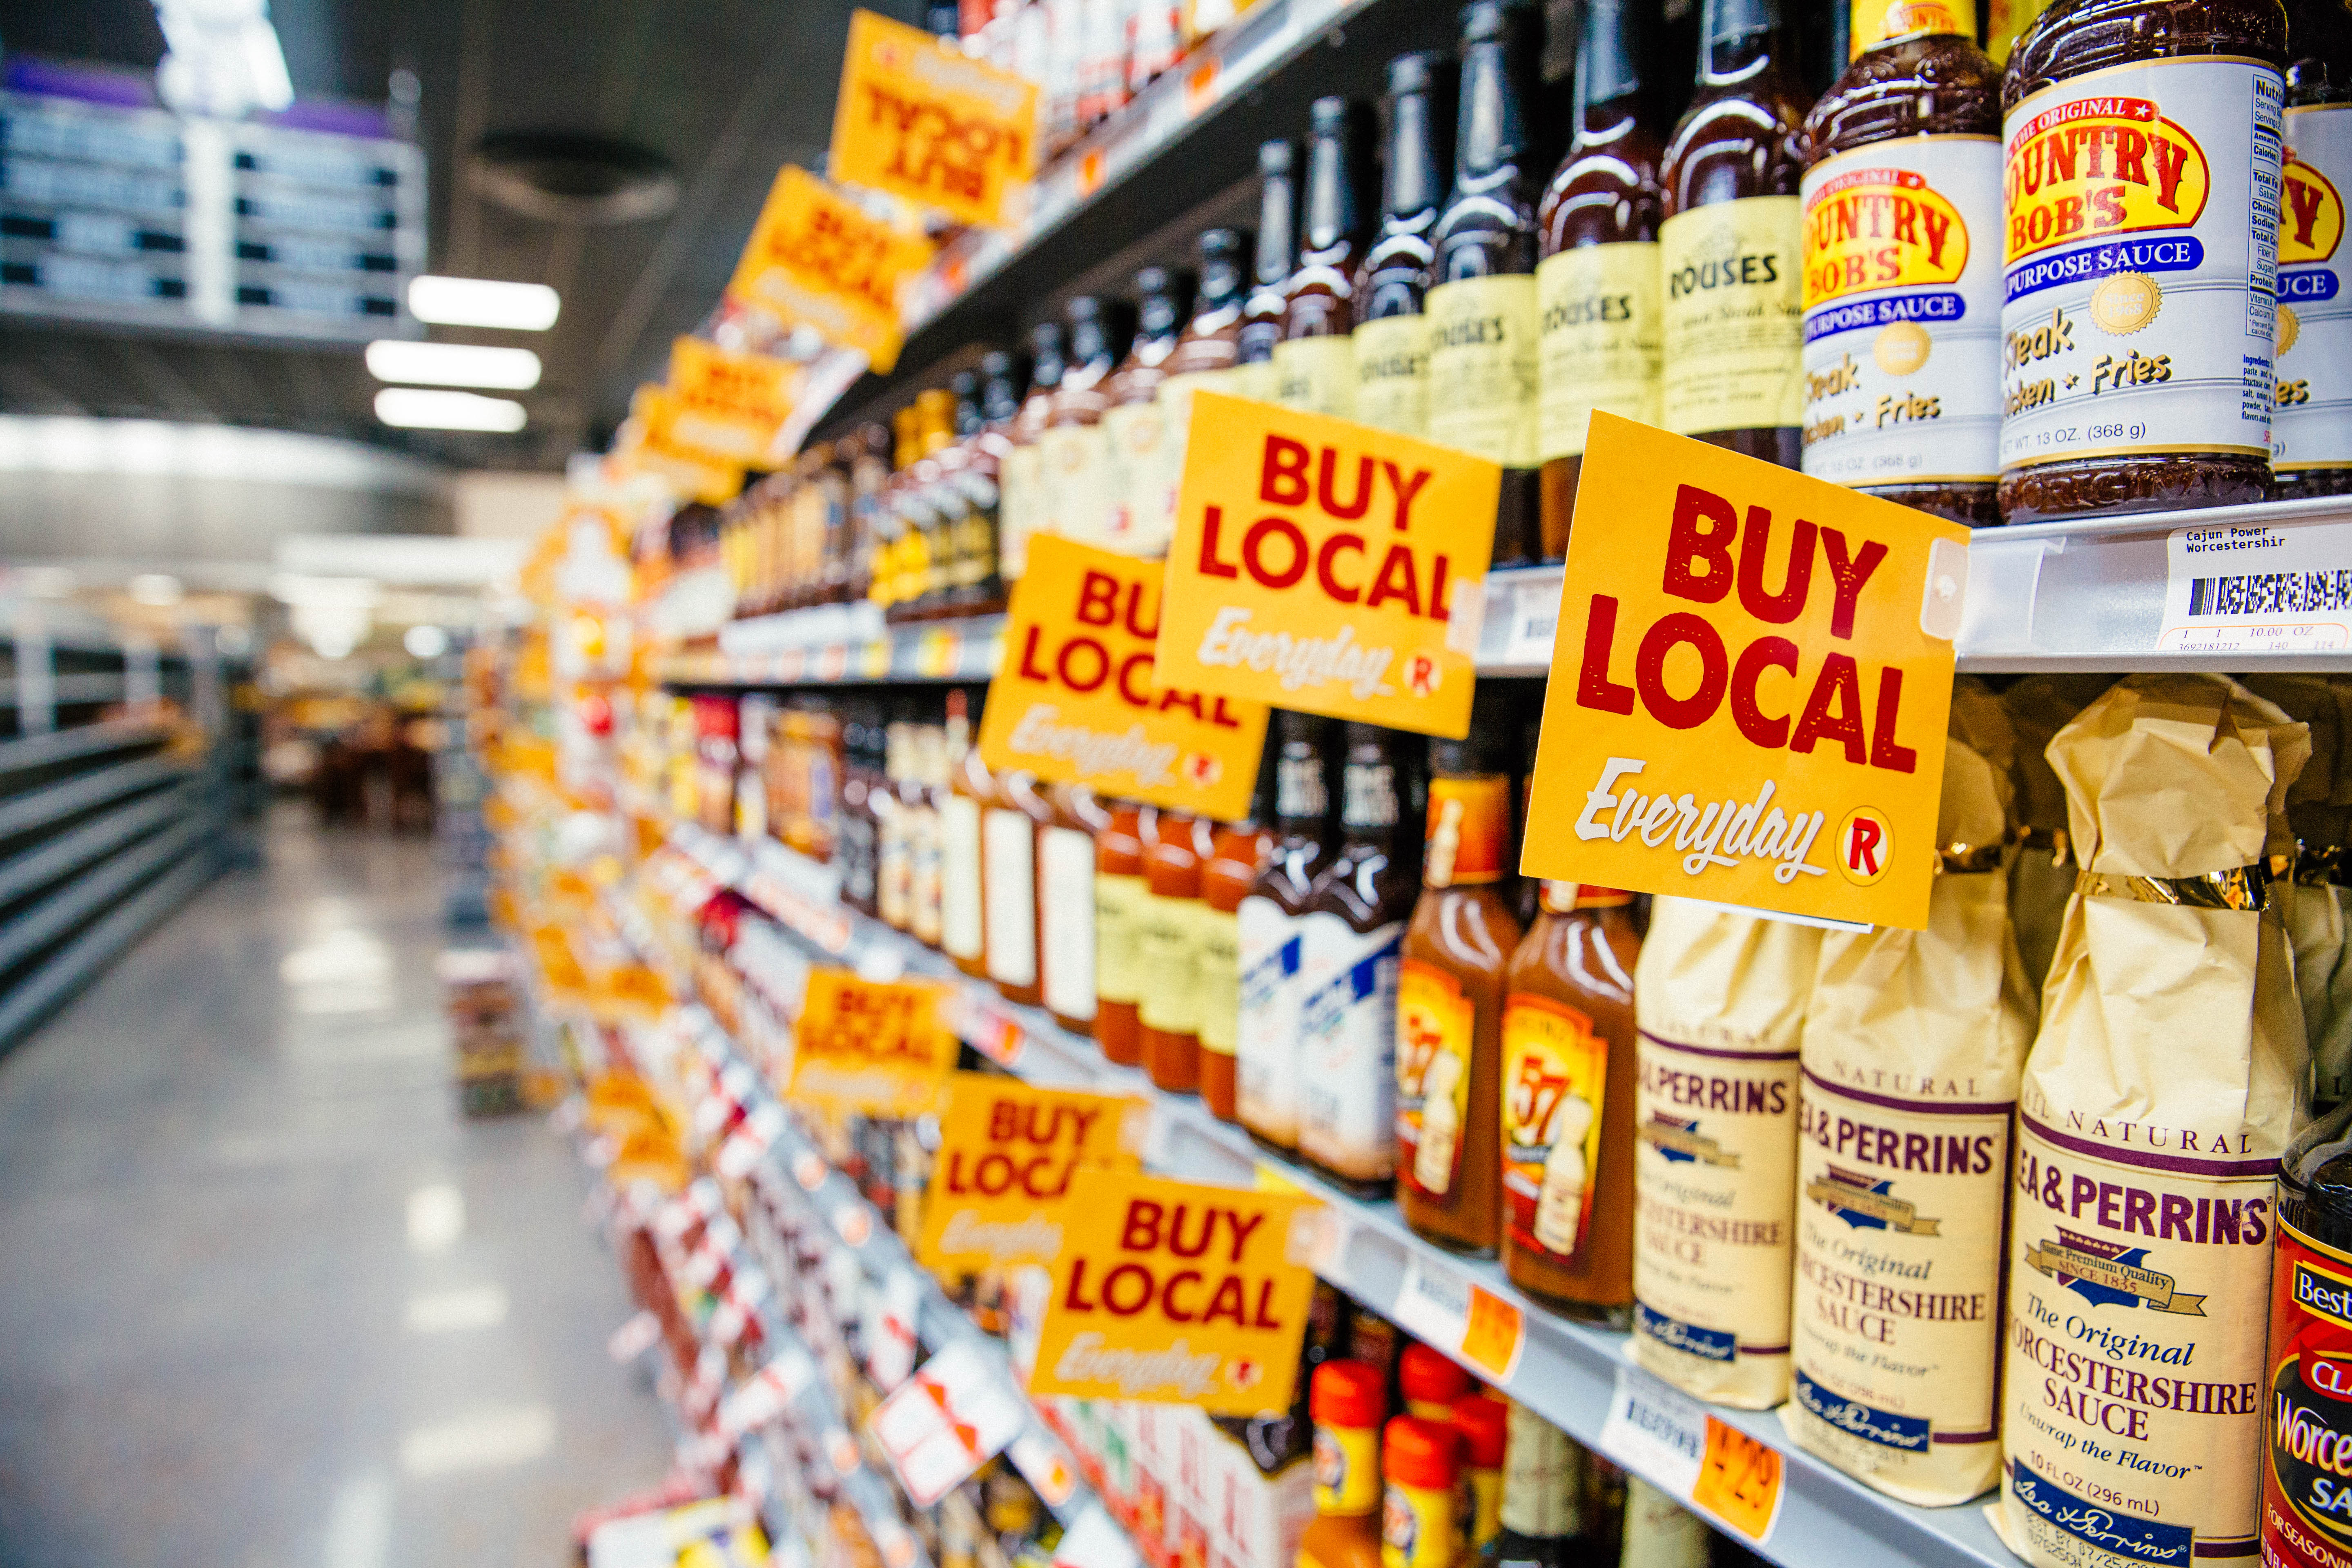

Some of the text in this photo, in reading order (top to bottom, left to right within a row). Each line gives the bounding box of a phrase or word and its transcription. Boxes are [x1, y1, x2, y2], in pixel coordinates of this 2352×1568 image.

[2013, 98, 2127, 149] THE ORIGINAL
[2255, 98, 2276, 116] Serving
[2254, 132, 2273, 145] Amount
[2254, 145, 2276, 161] Calories
[2004, 125, 2188, 216] OUNTRY
[2253, 172, 2271, 185] Total
[1807, 194, 1950, 270] UNTRY
[2012, 185, 2127, 254] BOB'S
[2252, 215, 2275, 231] Sodium
[2252, 230, 2269, 243] Total
[1810, 246, 1901, 299] BOB'S
[2098, 242, 2191, 275] SAUCE
[2257, 260, 2274, 274] Sugars
[2258, 245, 2271, 258] Fiber
[2104, 292, 2145, 307] Since
[2250, 274, 2273, 289] Protein
[2250, 293, 2270, 305] Vitamin
[1878, 296, 1957, 320] SAUCE
[2107, 303, 2143, 318] 1968
[2249, 306, 2270, 318] Calcium
[2091, 348, 2172, 395] Fries
[2243, 368, 2258, 376] paste
[2243, 377, 2263, 388] fructose
[1876, 390, 1941, 428] Fries
[2242, 401, 2261, 412] powder,
[2243, 389, 2254, 399] salt,
[2037, 431, 2051, 445] 13
[2056, 428, 2081, 443] OZ.
[2088, 424, 2124, 442] (368
[2130, 422, 2147, 439] g)
[2242, 411, 2258, 421] flavors
[1258, 432, 1432, 532] BUY
[2186, 526, 2270, 542] Cajun Power
[2186, 536, 2286, 553] Worcestershir
[1198, 505, 1452, 623] LOCAL
[1662, 483, 1889, 640] BUY
[1076, 569, 1160, 640] BU
[1197, 606, 1395, 701] Everyday
[2183, 626, 2315, 639] 1 1 10.00 OZ
[1576, 594, 1917, 774] LOCAL
[1574, 757, 1828, 884] Everyday
[1850, 817, 1879, 876] R
[1834, 1060, 1980, 1097] NATURAL
[989, 1099, 1102, 1148] BUY
[2066, 1110, 2253, 1154] NATURAL
[947, 1150, 1076, 1200] LOC
[1120, 1199, 1266, 1262] BUY
[1836, 1238, 1933, 1281] Original
[2058, 1260, 2137, 1294] SINCE 1835
[2066, 1247, 2117, 1274] Premium
[2120, 1265, 2170, 1290] Quality
[1065, 1258, 1282, 1330] LOCAL
[2299, 1272, 2352, 1319] Best
[1816, 1295, 1895, 1345] SAUCE
[2028, 1292, 2196, 1367] The Original
[2011, 1318, 2257, 1414] ORCESTERSHIRE
[2043, 1378, 2149, 1441] SAUCE
[2019, 1401, 2076, 1450] Unwrap
[2082, 1440, 2112, 1462] the
[2031, 1450, 2160, 1517] 10 FL OZ (296 mL)
[2069, 1509, 2178, 1559] Perrins
[2267, 1502, 2285, 1534] FOR
